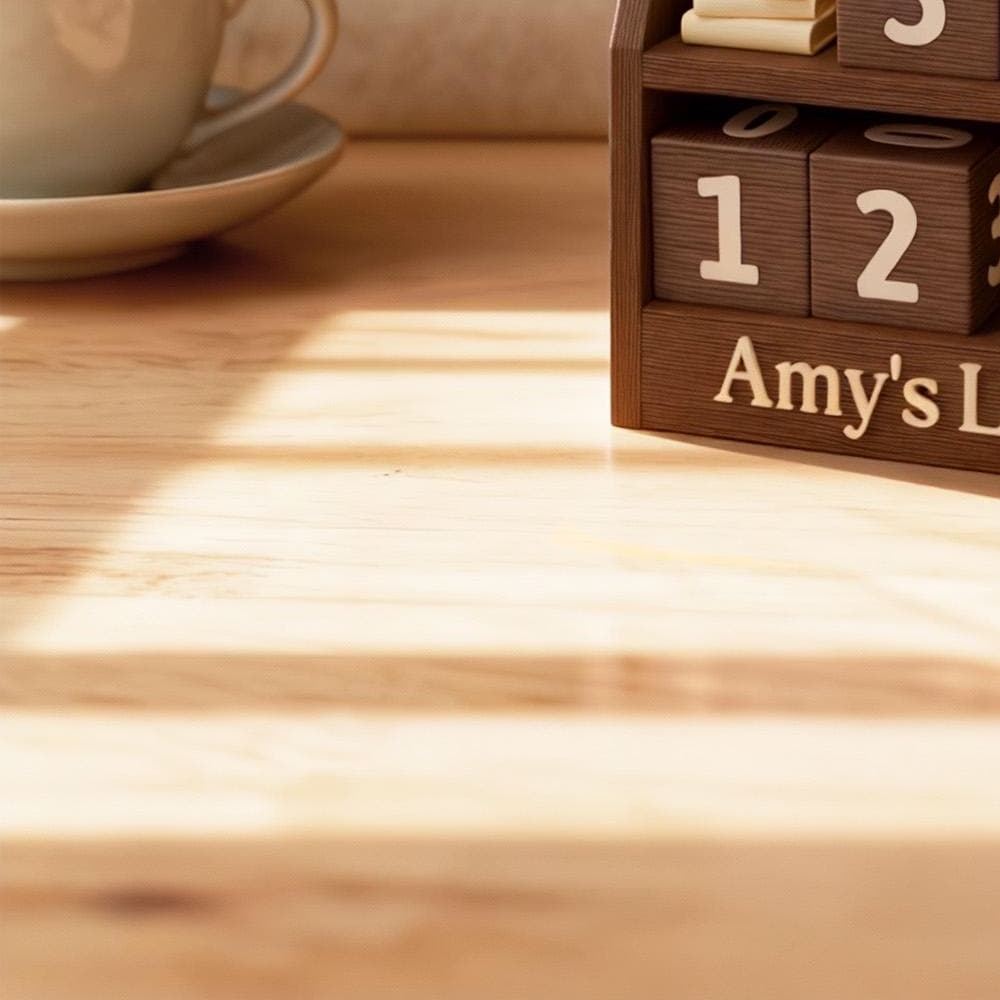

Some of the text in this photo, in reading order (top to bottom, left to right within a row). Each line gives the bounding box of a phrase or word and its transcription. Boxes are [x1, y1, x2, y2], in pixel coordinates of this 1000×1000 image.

[696, 174, 920, 304] 1 2
[713, 335, 942, 440] Amy's
